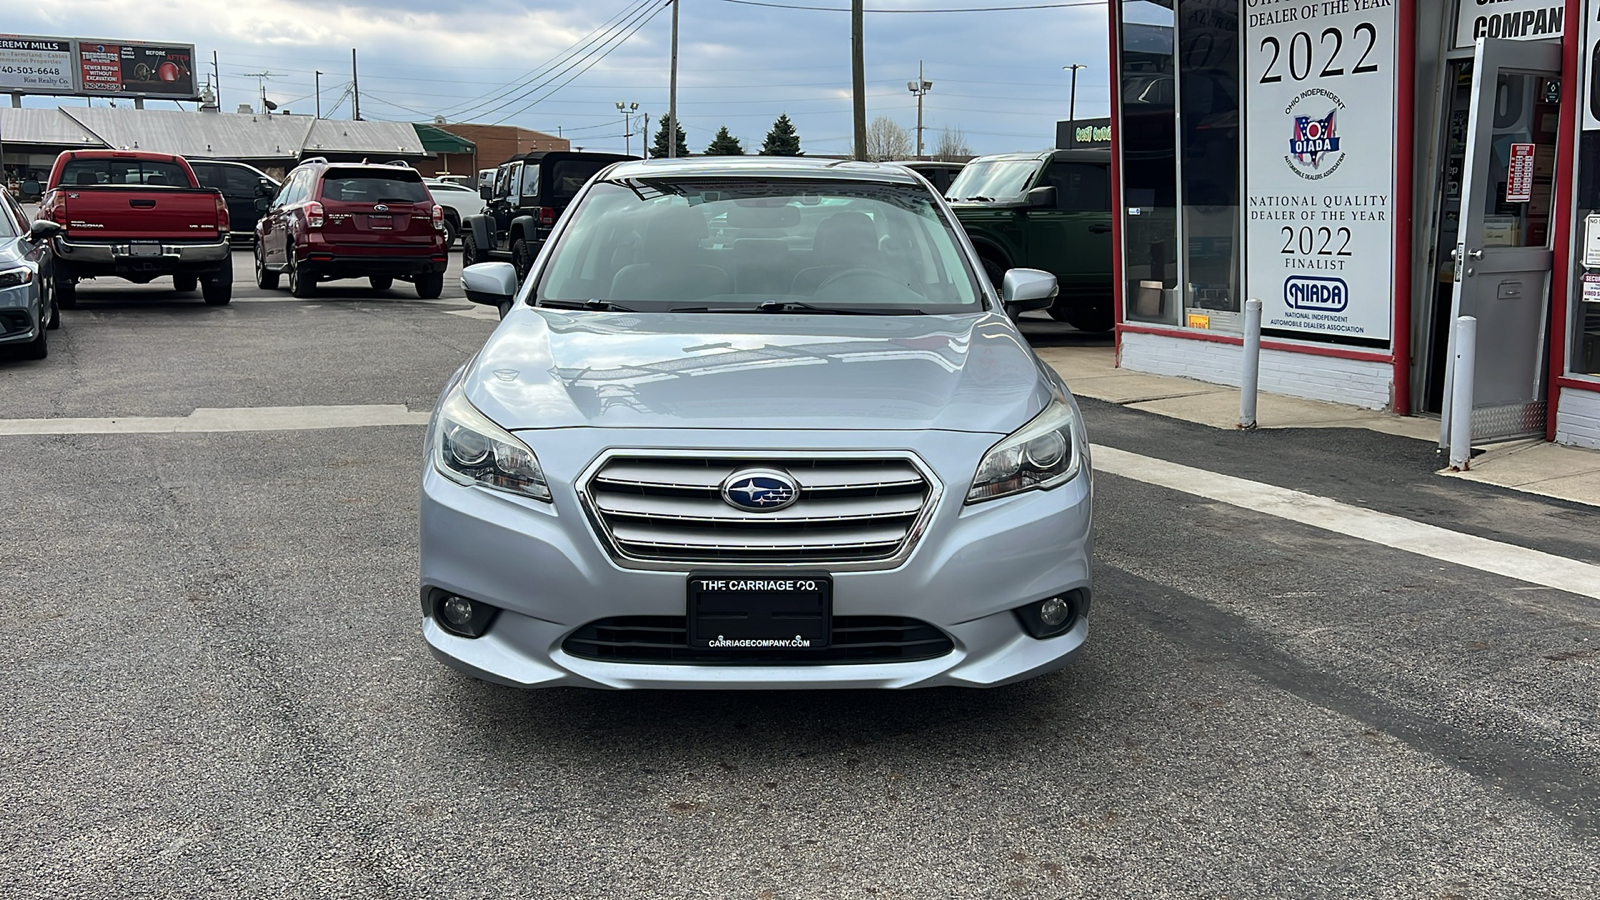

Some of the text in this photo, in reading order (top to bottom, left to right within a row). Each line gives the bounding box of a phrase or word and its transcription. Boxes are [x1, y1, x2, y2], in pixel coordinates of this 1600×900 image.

[1250, 8, 1298, 27] DEALER
[1301, 4, 1319, 20] OF
[1322, 1, 1349, 16] THE
[1354, 0, 1391, 11] YEAR
[31, 42, 59, 50] MILLS
[1259, 22, 1378, 84] 2022
[0, 66, 60, 75] 40-503-6648
[38, 77, 57, 86] Realty
[1285, 88, 1346, 115] OHIO INDEPENDENT
[1295, 139, 1331, 153] OIADA
[1323, 152, 1346, 178] ASSOCIATION
[1250, 195, 1388, 208] NATIONAL QUALITY
[1251, 210, 1386, 221] DEALER OF THE YEAR
[1280, 226, 1352, 256] 2022
[1285, 258, 1346, 270] FINALIST
[1288, 282, 1343, 307] NIADA
[1284, 311, 1348, 322] NATIONAL INDEPENDENT
[1270, 319, 1364, 334] AUTOMOBILE DEALERS ASSOCIATION
[701, 580, 818, 591] THE CARRIAGE CO.
[708, 640, 810, 648] CARRIAGECOMPANY.COM
